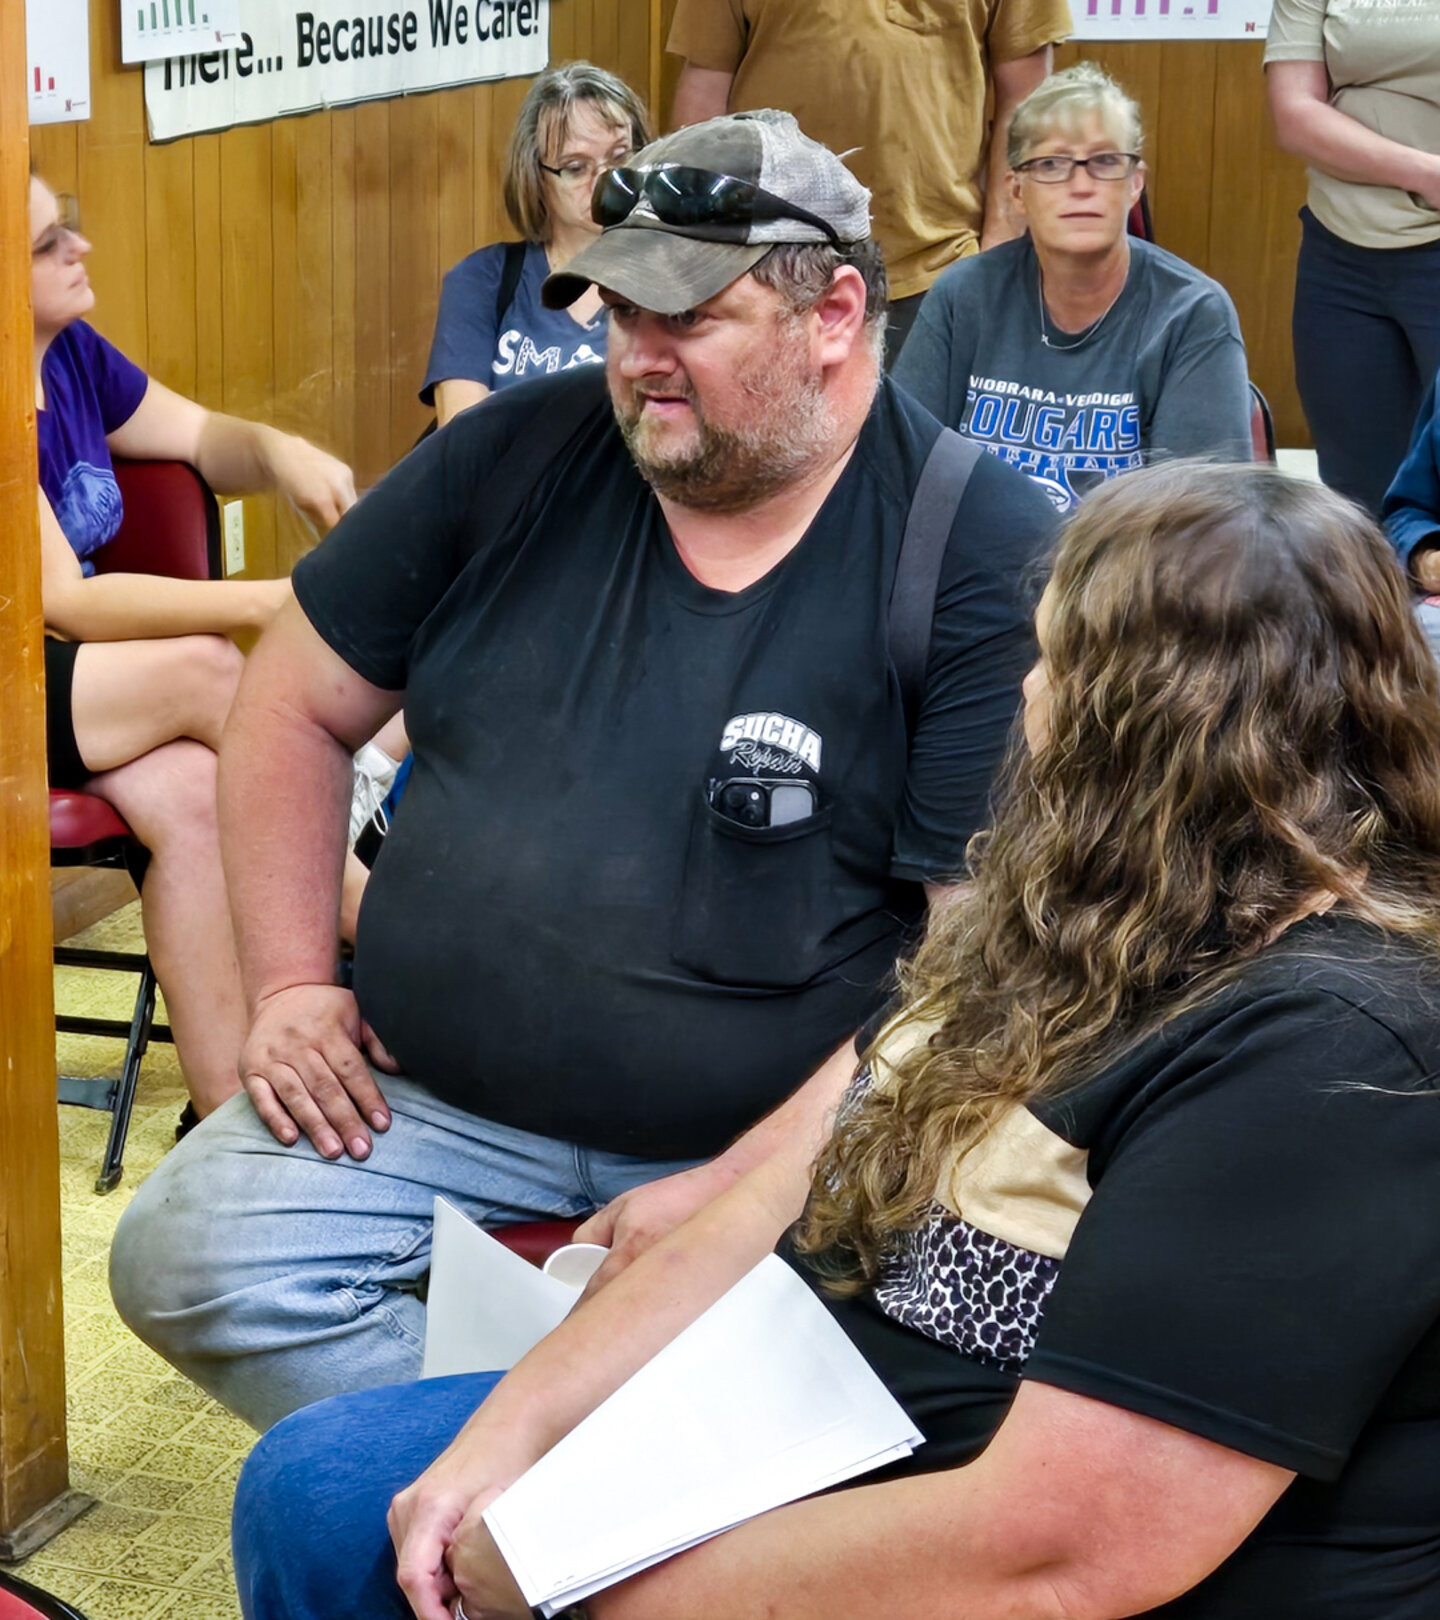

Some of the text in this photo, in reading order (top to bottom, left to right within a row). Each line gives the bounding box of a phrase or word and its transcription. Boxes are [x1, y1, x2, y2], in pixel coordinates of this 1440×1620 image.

[296, 11, 418, 68] Because
[428, 0, 468, 48] We
[475, 0, 539, 42] Care!
[720, 711, 822, 774] SUCHA
